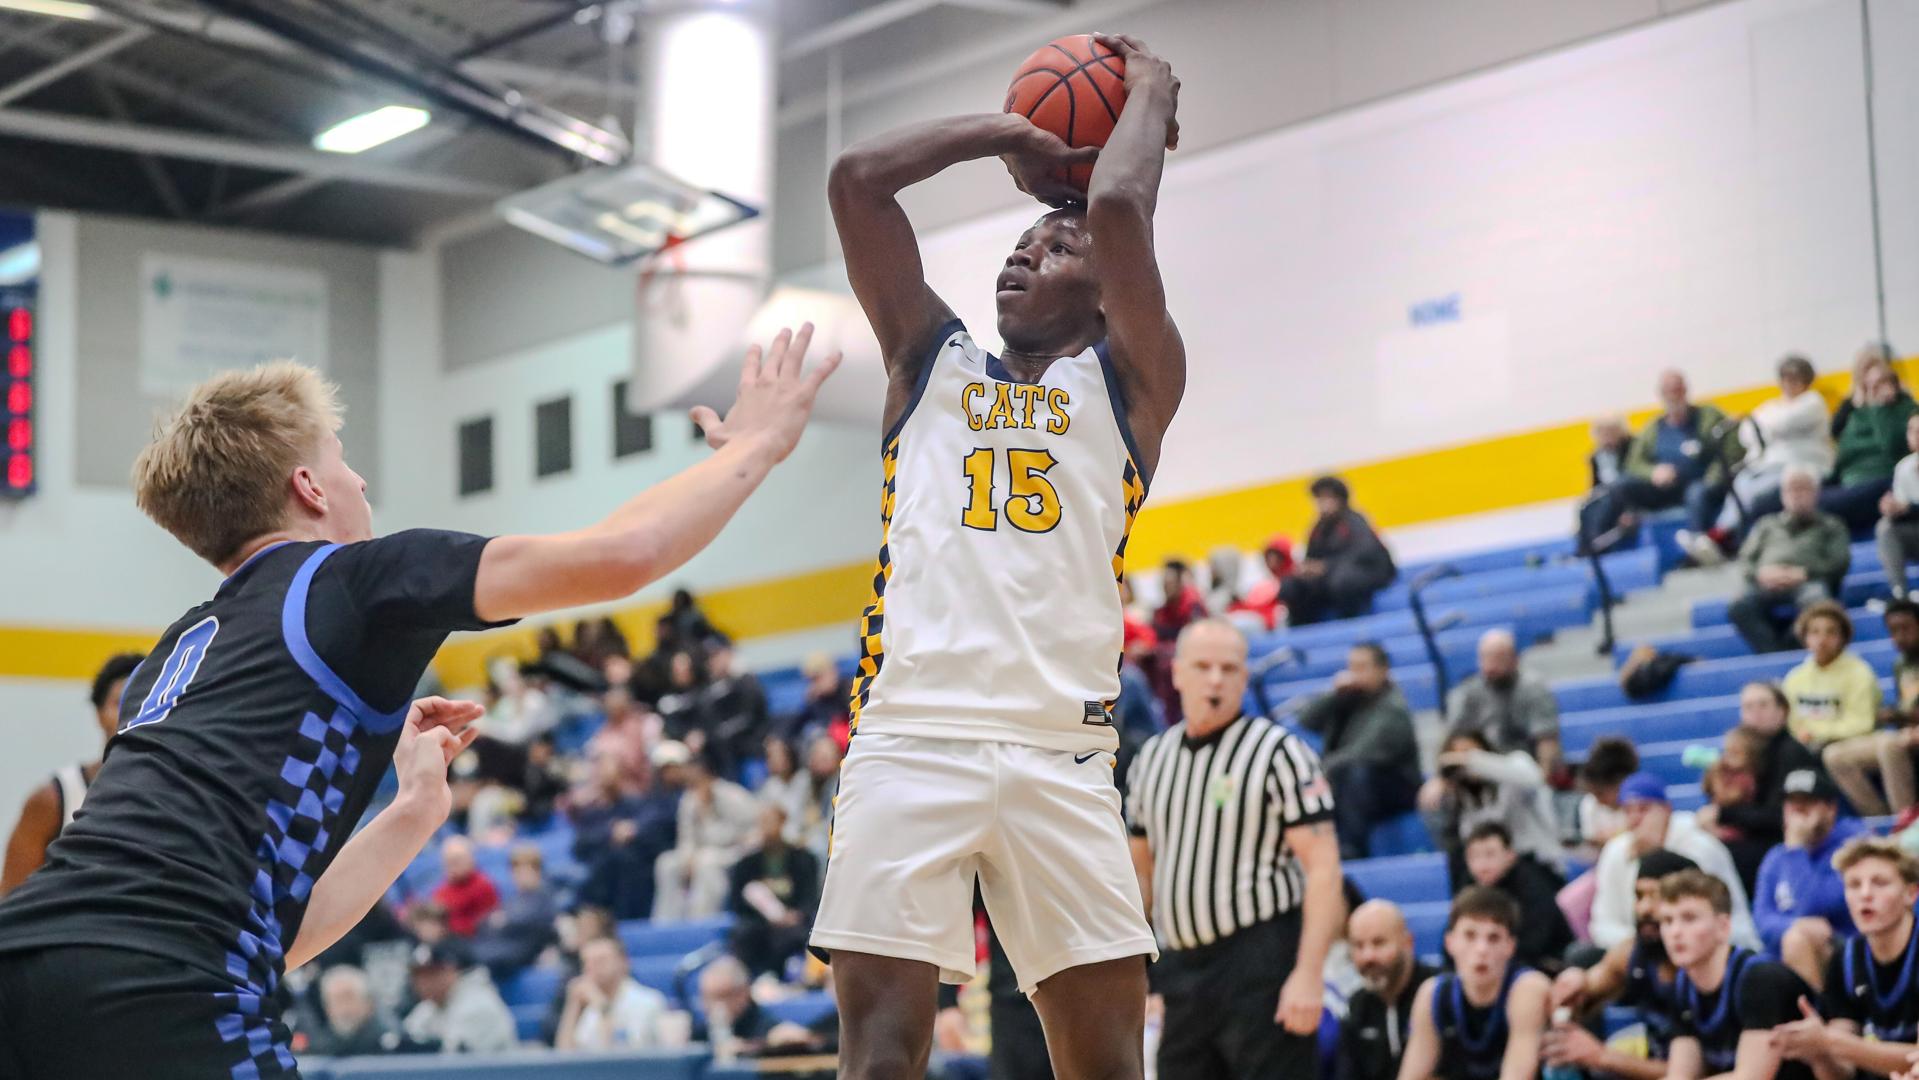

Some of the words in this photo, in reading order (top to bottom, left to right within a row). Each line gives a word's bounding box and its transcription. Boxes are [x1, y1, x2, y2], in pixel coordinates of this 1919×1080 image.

[962, 382, 1071, 435] CATS
[961, 447, 1064, 534] 15
[117, 615, 220, 735] 0
